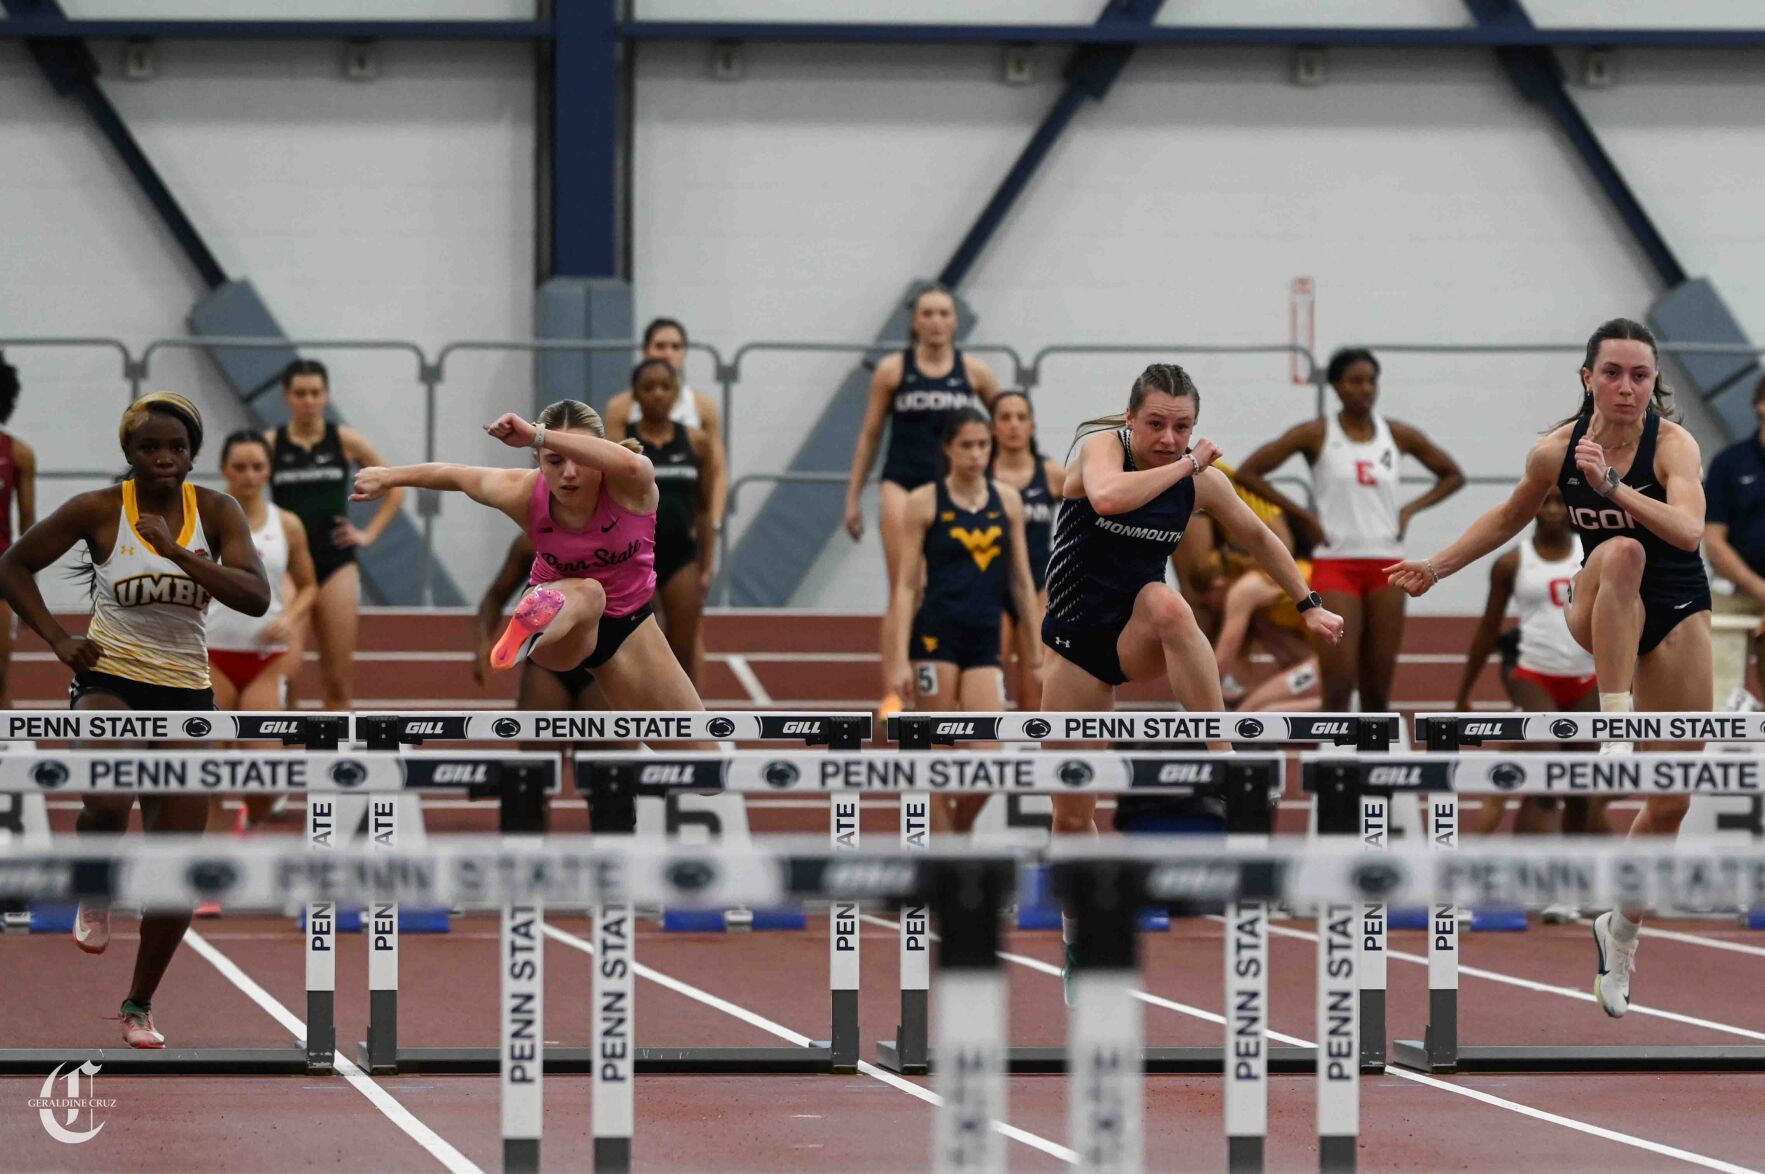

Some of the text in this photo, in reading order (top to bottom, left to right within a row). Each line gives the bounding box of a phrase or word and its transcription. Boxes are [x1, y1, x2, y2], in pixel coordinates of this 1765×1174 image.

[1095, 517, 1184, 543] MONMOUTH
[541, 553, 591, 572] Penn
[919, 666, 933, 692] 5
[9, 717, 168, 738] PENN STATE
[259, 721, 299, 734] GILL
[405, 721, 444, 734] GILL
[534, 717, 692, 738] PENN STATE
[782, 721, 821, 734] GILL
[936, 722, 975, 735] GILL
[1065, 717, 1221, 739] PENN STATE
[1310, 722, 1349, 735] GILL
[1464, 722, 1503, 736] GILL
[1592, 718, 1747, 739] PENN STATE
[89, 759, 308, 790] PENN STATE
[432, 764, 487, 784] GILL
[639, 764, 695, 784] GILL
[820, 759, 1034, 789] PENN STATE
[1157, 763, 1214, 784] GILL
[1368, 765, 1422, 786] GILL
[1546, 761, 1758, 791] PENN STATE
[511, 993, 535, 1083] PENN
[602, 991, 626, 1082] PENN
[1236, 991, 1260, 1081] PENN
[1328, 991, 1353, 1081] PENN
